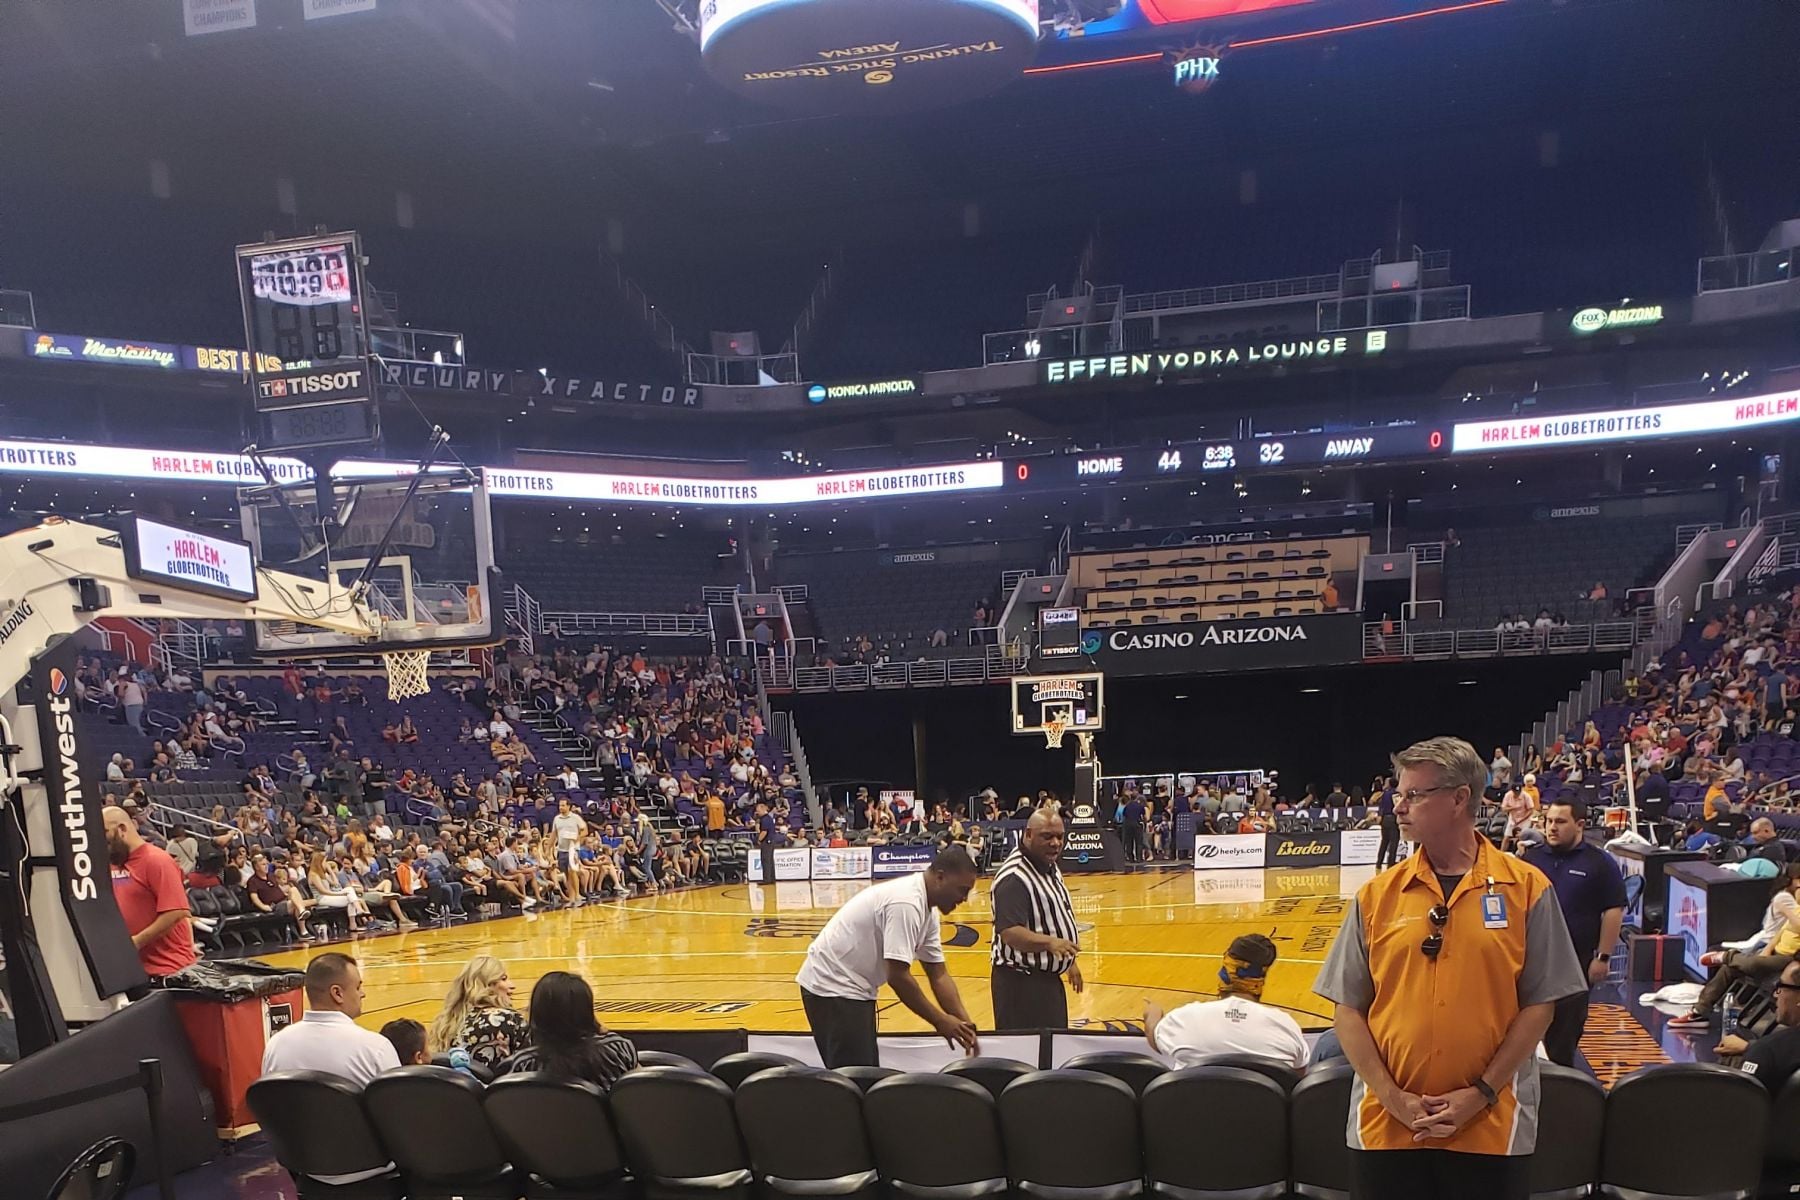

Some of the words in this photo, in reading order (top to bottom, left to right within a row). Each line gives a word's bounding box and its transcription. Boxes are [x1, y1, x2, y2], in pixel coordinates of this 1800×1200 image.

[193, 7, 248, 27] CHAMPIONS
[818, 40, 901, 60] ARENA
[902, 40, 1004, 64] TALKING
[743, 66, 831, 82] RESORT
[832, 57, 898, 73] STICK
[1173, 56, 1221, 82] PHX
[1581, 312, 1600, 323] FOX
[1605, 305, 1664, 325] ARIZONA
[82, 338, 175, 368] Mercury
[196, 346, 238, 372] BEST
[1046, 354, 1150, 383] EFFEN
[1157, 347, 1241, 370] VODKA
[1249, 337, 1348, 362] LOUNGE
[286, 370, 362, 395] TISSOT
[827, 384, 869, 399] KONICA
[869, 379, 916, 394] MINOLTA
[1735, 397, 1799, 421] HARLEM
[1481, 423, 1541, 443] HARLEM
[1543, 413, 1662, 438] GLOBETROTTERS
[1324, 436, 1374, 458] AWAY
[1429, 431, 1442, 448] 0
[0, 447, 77, 467] TROTTERS
[1157, 450, 1182, 472] 44
[1205, 445, 1234, 461] 6:38
[1259, 442, 1285, 463] 32
[151, 455, 214, 475] HARLEM
[1017, 464, 1028, 481] 0
[1076, 456, 1124, 475] HOME
[611, 481, 661, 498] HARLEM
[662, 484, 758, 500] GLOBETROTTERS
[816, 479, 866, 496] HARLEM
[867, 471, 965, 492] GLOBETROTTERS
[1550, 504, 1600, 519] annexus
[174, 539, 221, 569] HARLEM
[893, 551, 936, 564] annexus
[166, 560, 231, 588] GLOBETROTTERS
[1109, 629, 1195, 652] CASINO
[1200, 623, 1308, 647] ARIZONA
[1053, 646, 1079, 655] TISSOT
[1039, 679, 1077, 692] HARLEM
[1032, 690, 1085, 702] GLOBETROTTERS
[46, 693, 98, 902] Southwest
[1064, 841, 1104, 850] ARIZONA
[1067, 832, 1101, 841] CASINO
[878, 851, 931, 863] Champion
[1219, 846, 1263, 857] heelys.com
[1275, 839, 1332, 857] Baden
